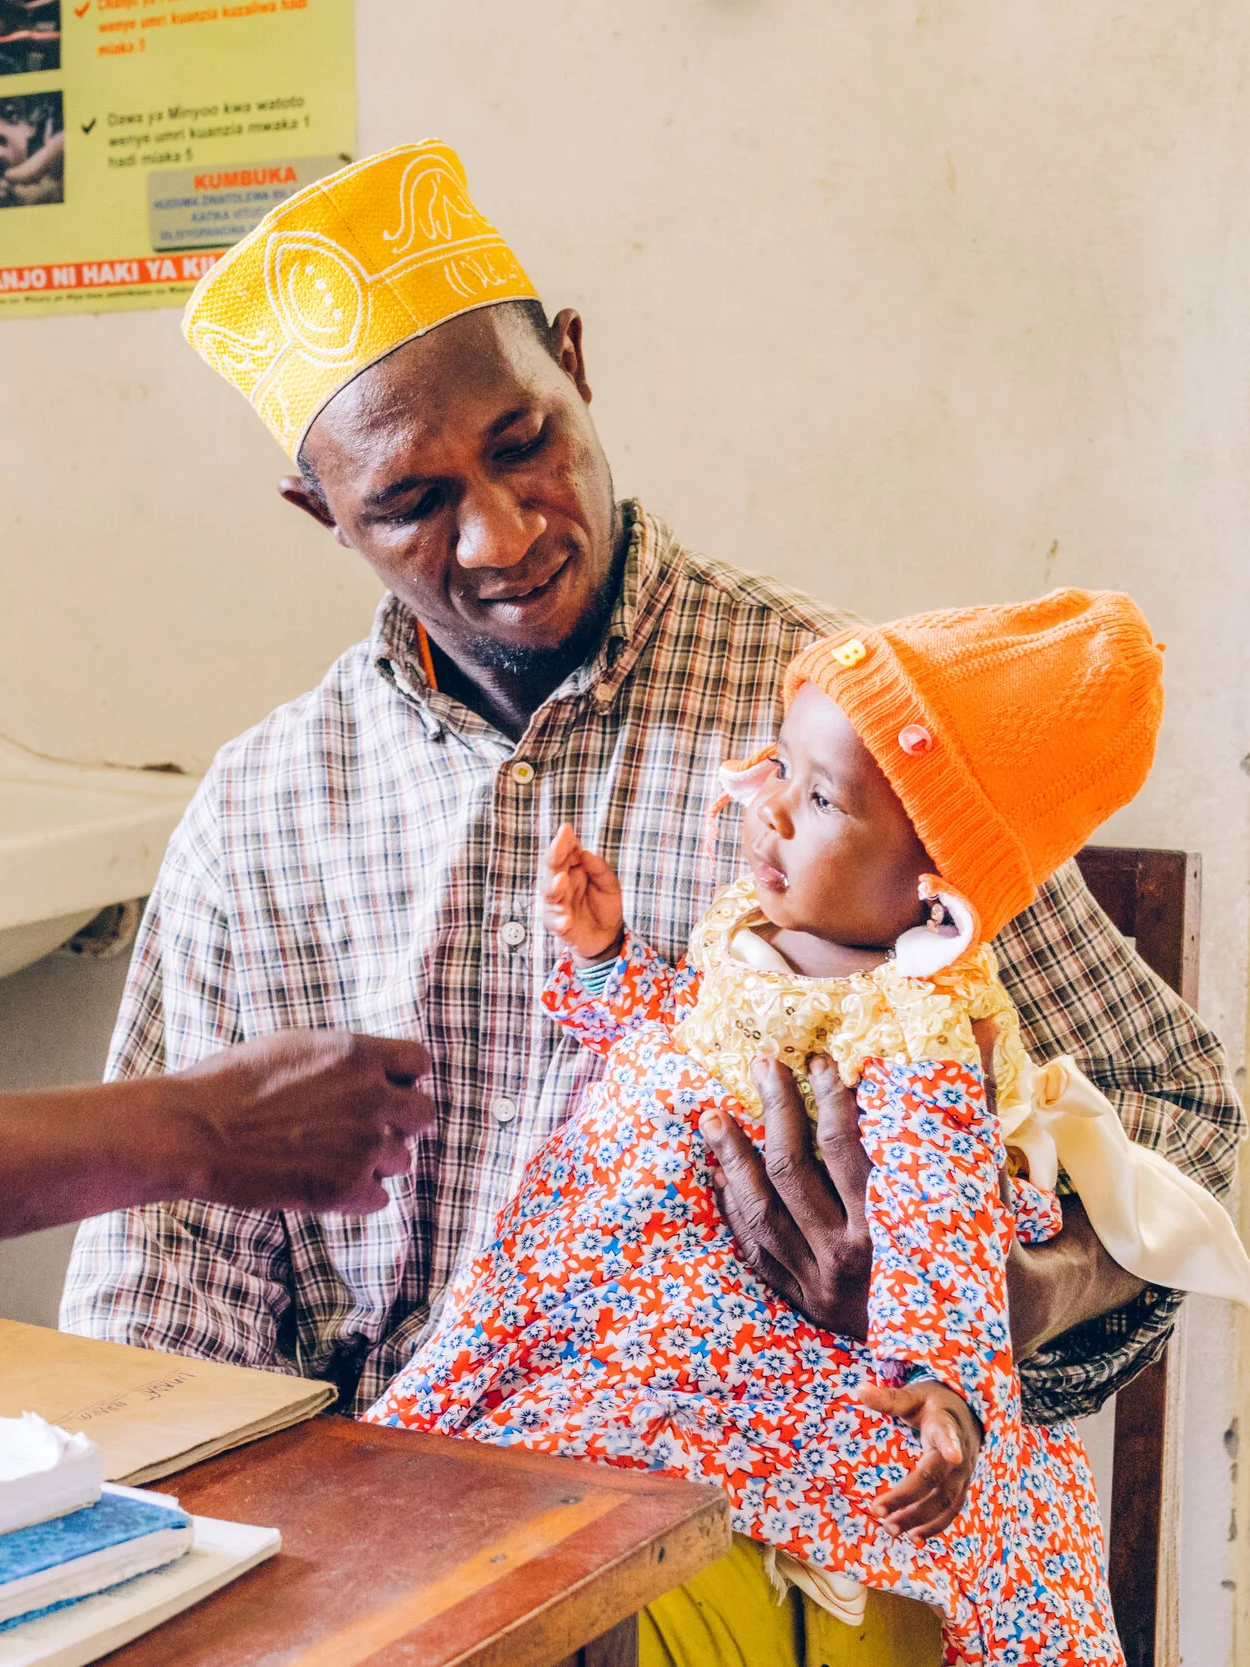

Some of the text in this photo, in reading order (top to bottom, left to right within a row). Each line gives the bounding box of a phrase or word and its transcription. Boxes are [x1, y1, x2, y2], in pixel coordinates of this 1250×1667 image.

[107, 96, 306, 127] Dawa ya Minyoo kwa watoto
[108, 134, 150, 148] wenye
[154, 127, 185, 142] umri
[189, 123, 243, 139] kuanzia
[248, 117, 298, 133] mwaka
[108, 152, 136, 168] hadi
[141, 150, 181, 165] miaka
[194, 166, 298, 191] KUMBUKA
[52, 266, 77, 287] NI
[82, 262, 139, 285] HAKI
[145, 259, 177, 280] YA
